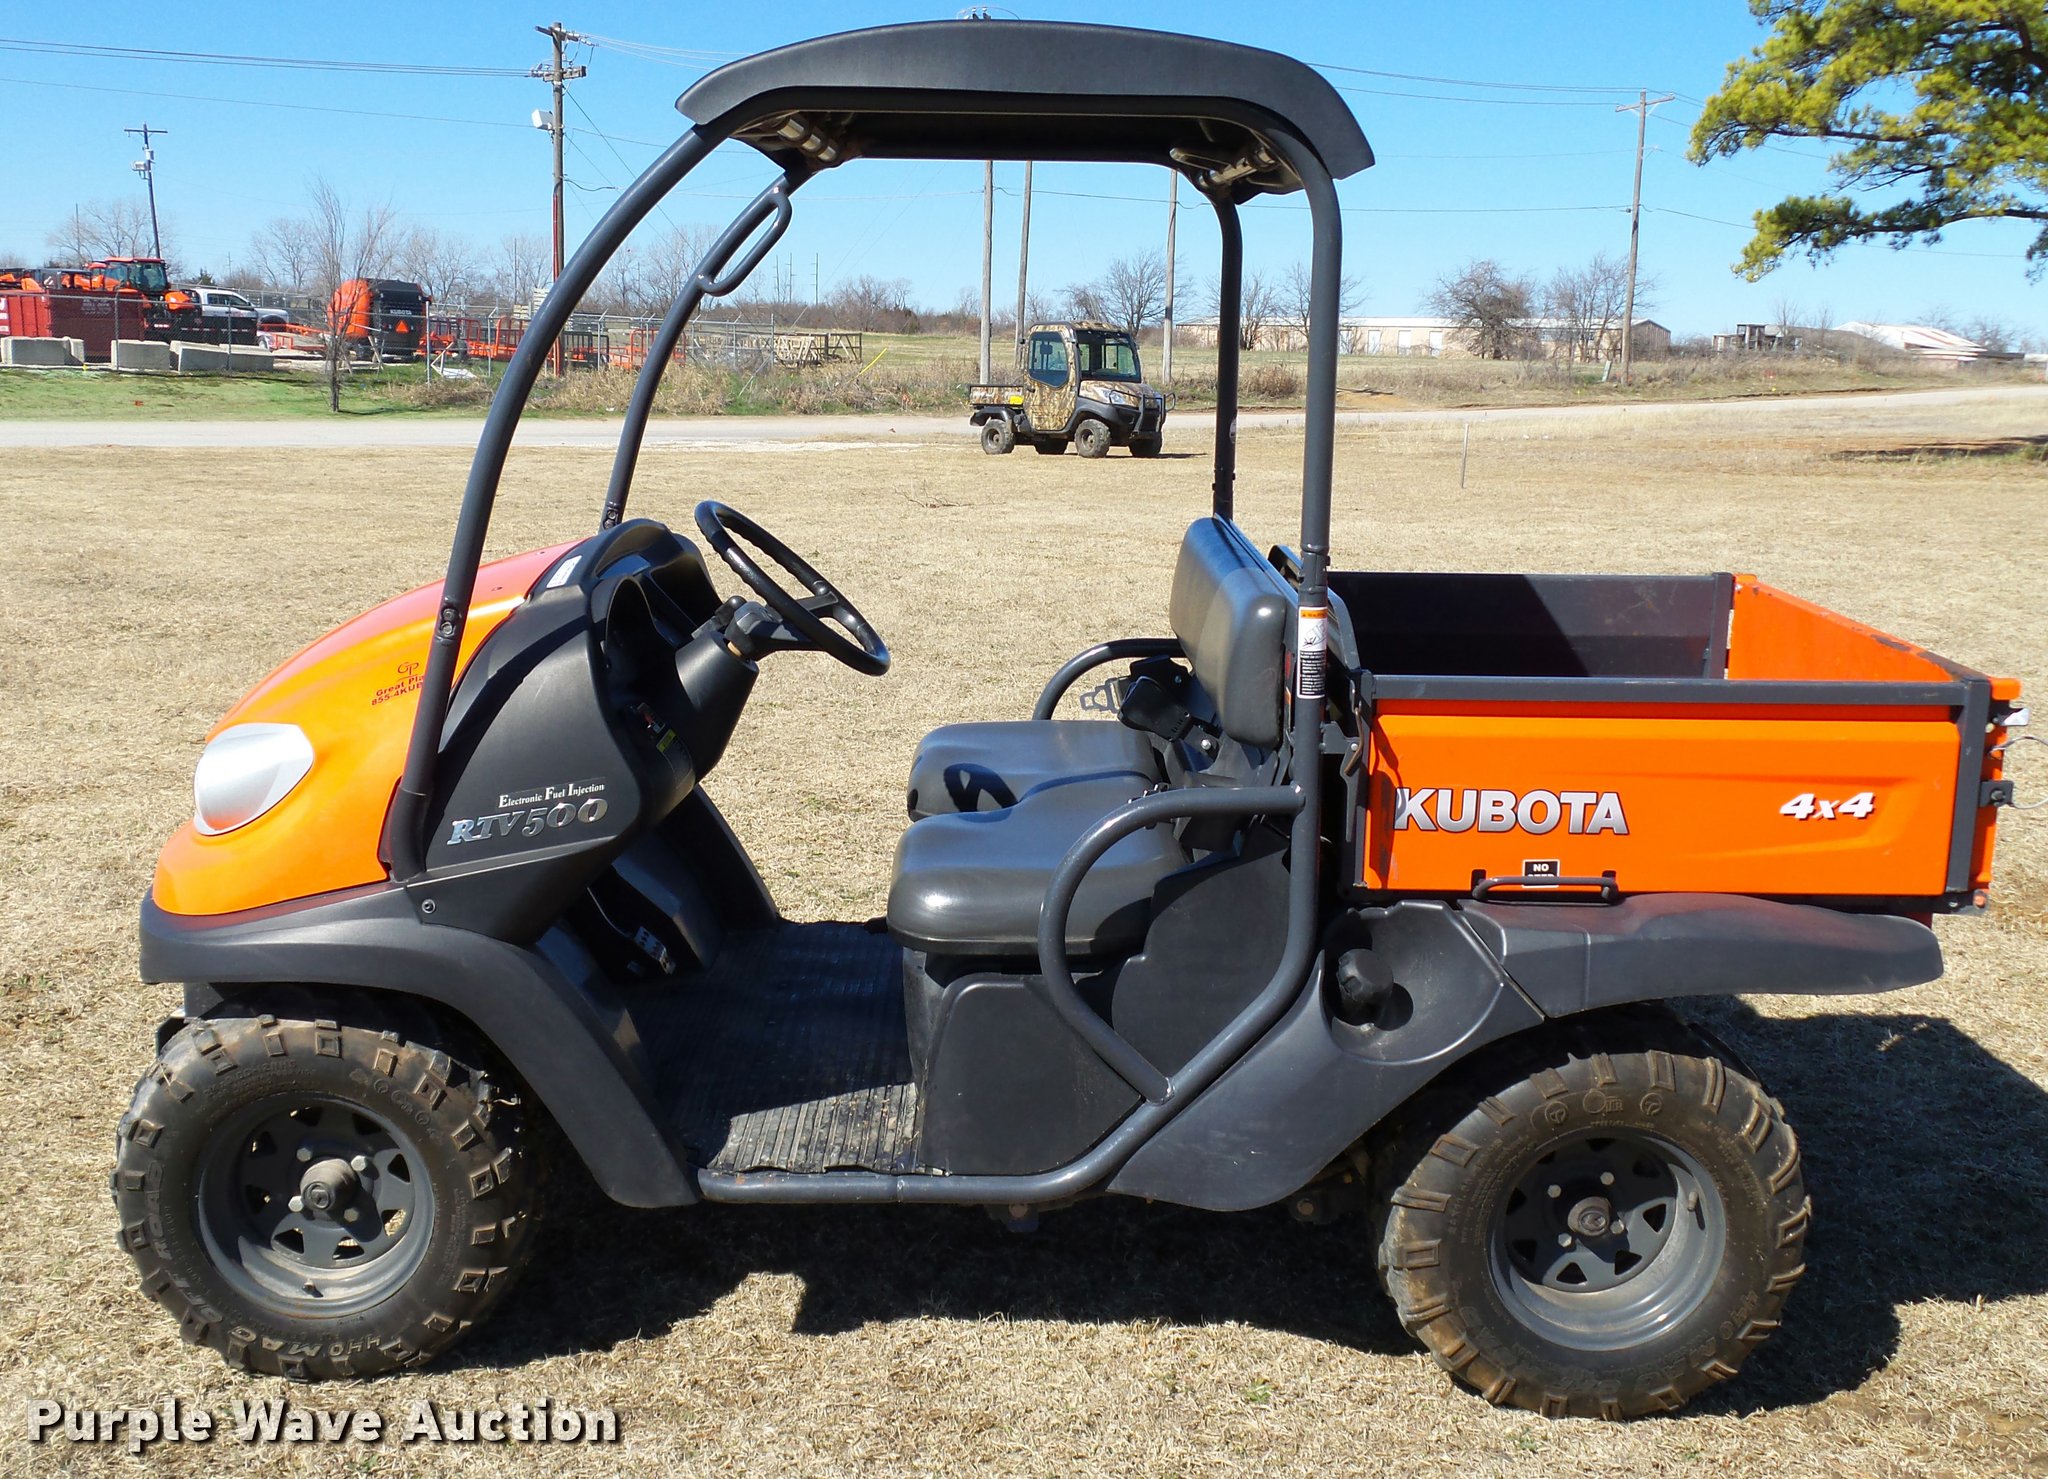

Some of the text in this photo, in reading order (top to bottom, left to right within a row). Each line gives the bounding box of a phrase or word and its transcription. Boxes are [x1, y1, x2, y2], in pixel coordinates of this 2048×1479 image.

[376, 681, 404, 697] Great
[498, 783, 605, 808] Electronic Fuel Injection
[1779, 792, 1875, 820] 4x4
[446, 798, 608, 845] RTV500
[1394, 787, 1630, 835] KUBOTA
[1532, 863, 1550, 872] NO
[145, 1160, 173, 1260] ROAD
[165, 1269, 223, 1323] OFF
[229, 1325, 322, 1357] MAG
[328, 1335, 382, 1358] 440
